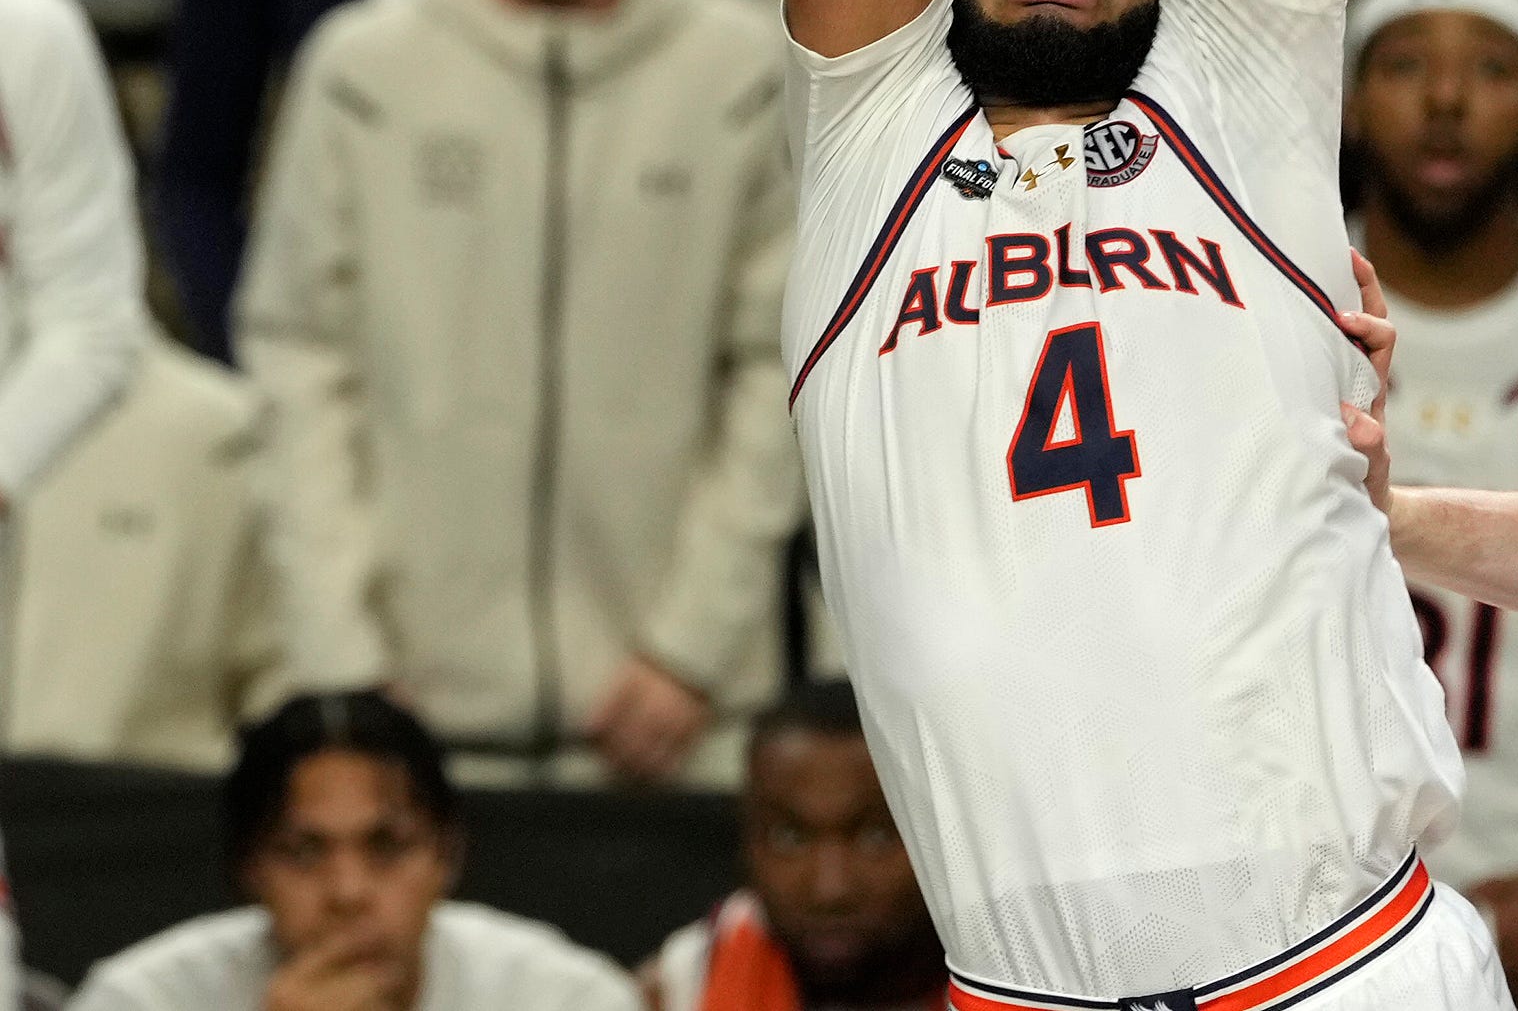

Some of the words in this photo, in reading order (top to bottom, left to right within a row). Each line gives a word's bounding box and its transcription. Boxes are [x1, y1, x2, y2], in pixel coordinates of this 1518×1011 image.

[1084, 125, 1137, 170] SEC
[946, 163, 977, 183] FINAL
[1006, 321, 1142, 529] 4
